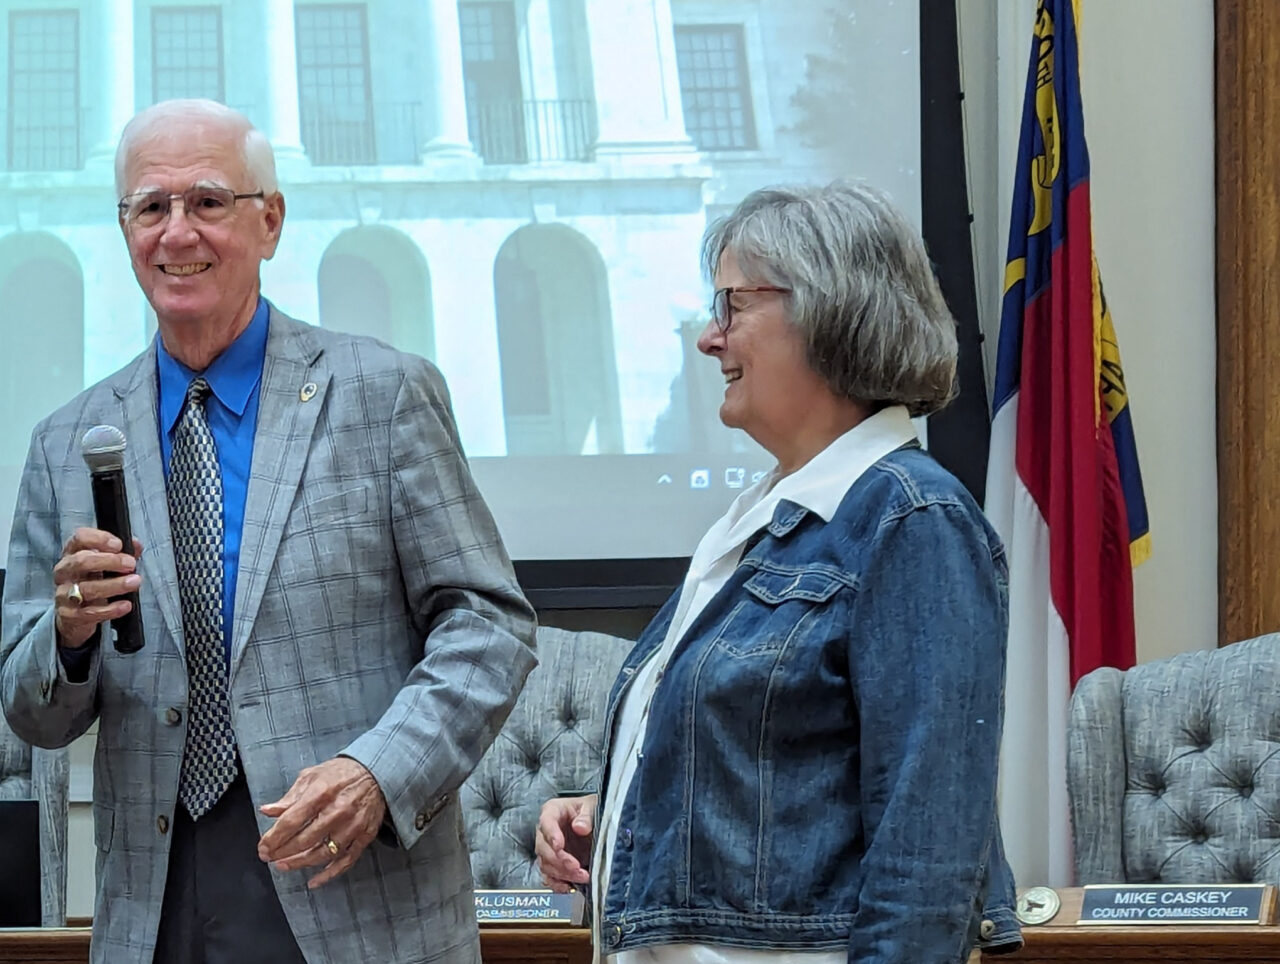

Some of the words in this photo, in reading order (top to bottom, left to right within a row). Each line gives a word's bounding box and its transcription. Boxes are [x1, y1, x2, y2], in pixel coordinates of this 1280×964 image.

[474, 895, 551, 908] KLUSMAN
[1114, 892, 1157, 905] MIKE
[1161, 891, 1232, 905] CASKEY
[1092, 907, 1146, 918] COUNTY
[1147, 906, 1249, 918] COMMISSIONER
